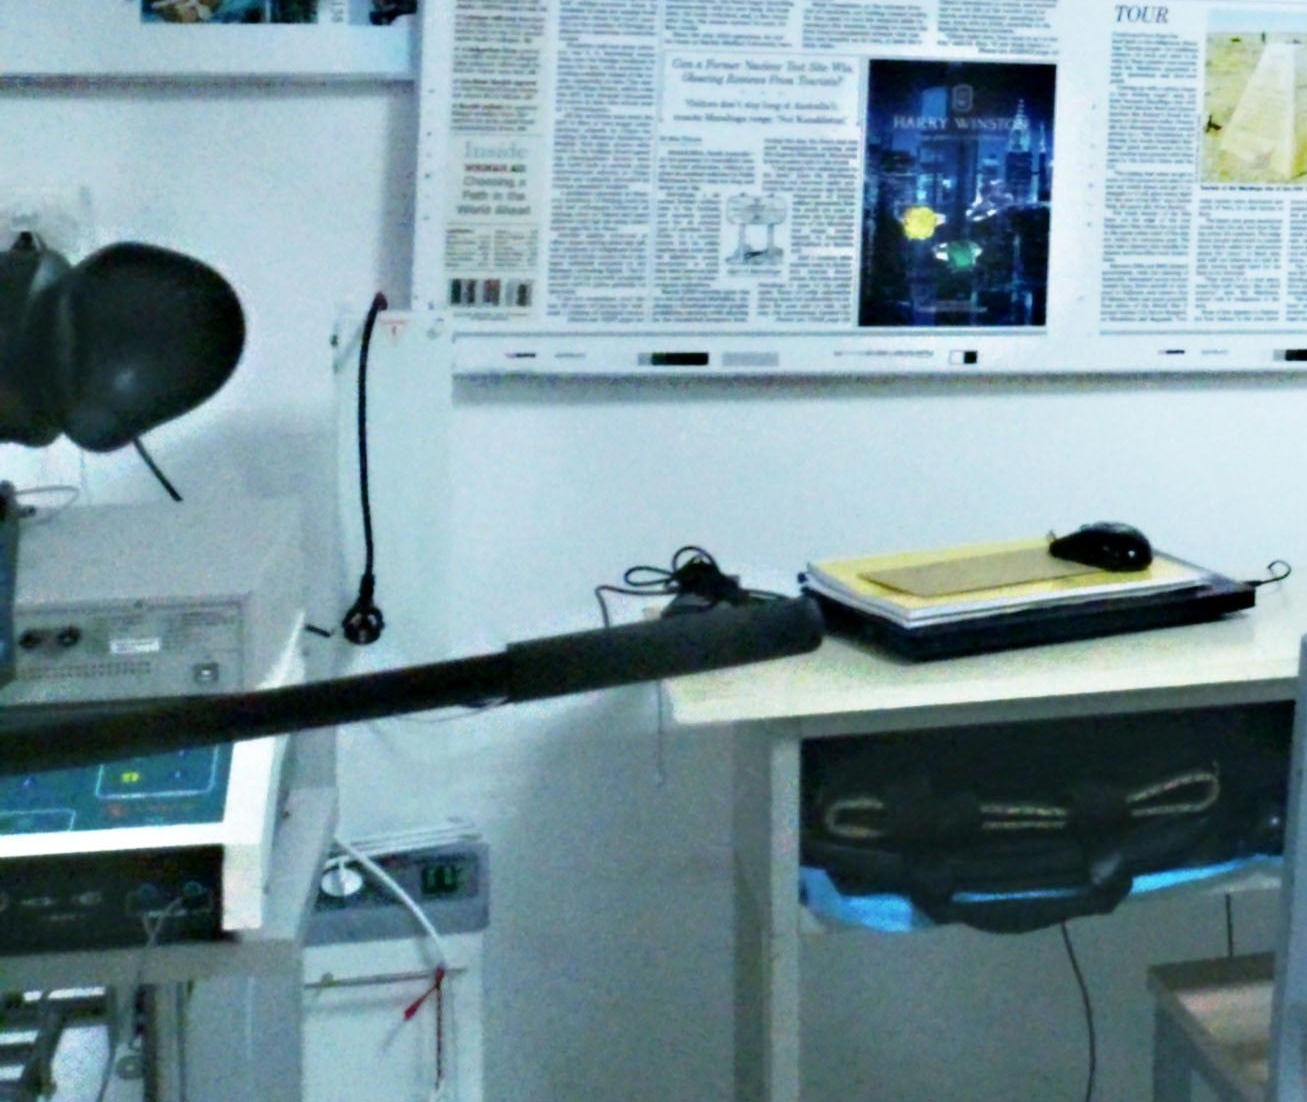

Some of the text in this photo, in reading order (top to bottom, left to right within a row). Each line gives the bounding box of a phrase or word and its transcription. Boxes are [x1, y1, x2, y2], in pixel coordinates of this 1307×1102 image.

[1114, 5, 1169, 24] TOUR
[892, 115, 1029, 131] HARRY WINSTON
[456, 204, 492, 215] World
